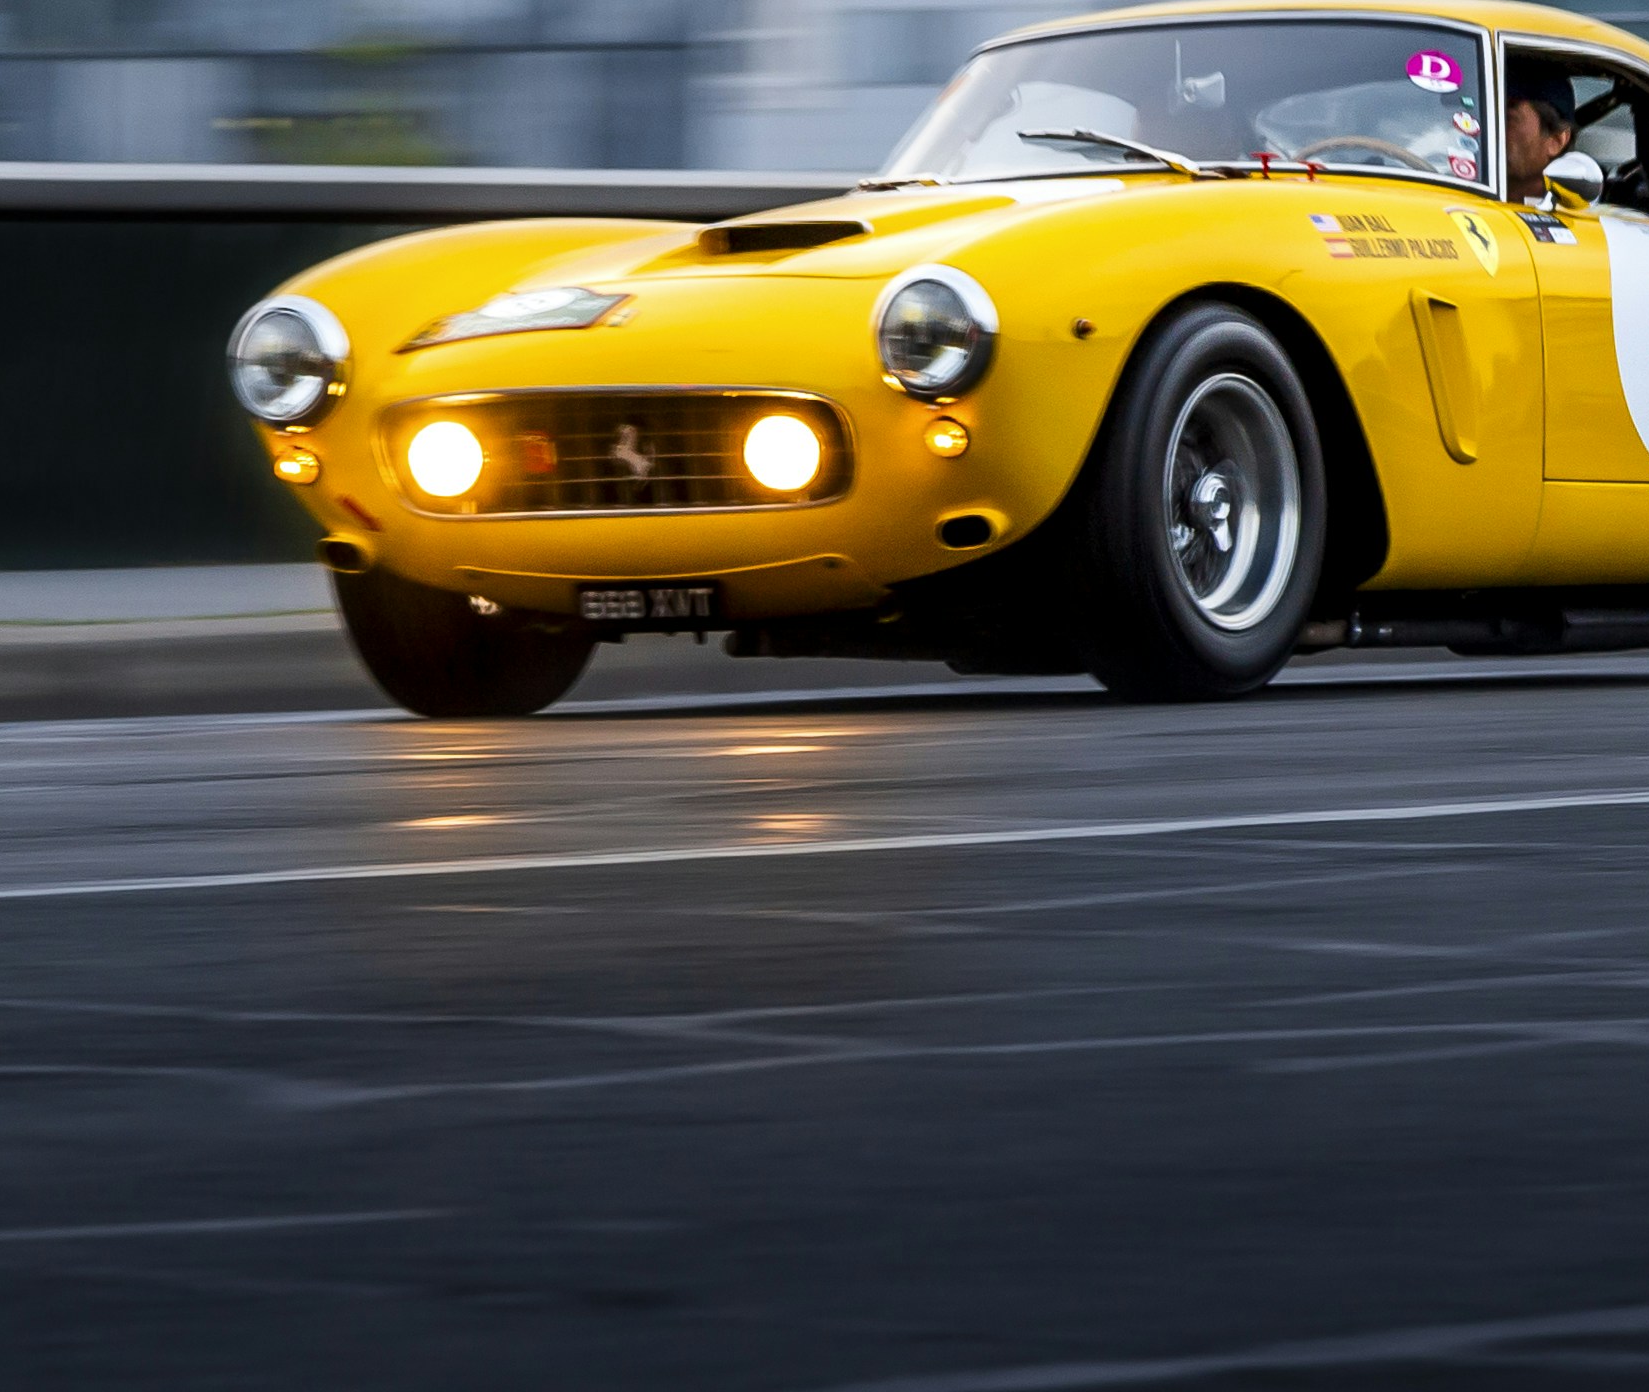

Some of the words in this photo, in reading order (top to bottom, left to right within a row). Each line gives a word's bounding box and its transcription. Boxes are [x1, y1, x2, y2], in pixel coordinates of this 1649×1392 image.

[1420, 54, 1451, 79] D
[1362, 214, 1397, 233] BALL
[1406, 238, 1459, 260] PALACIOS
